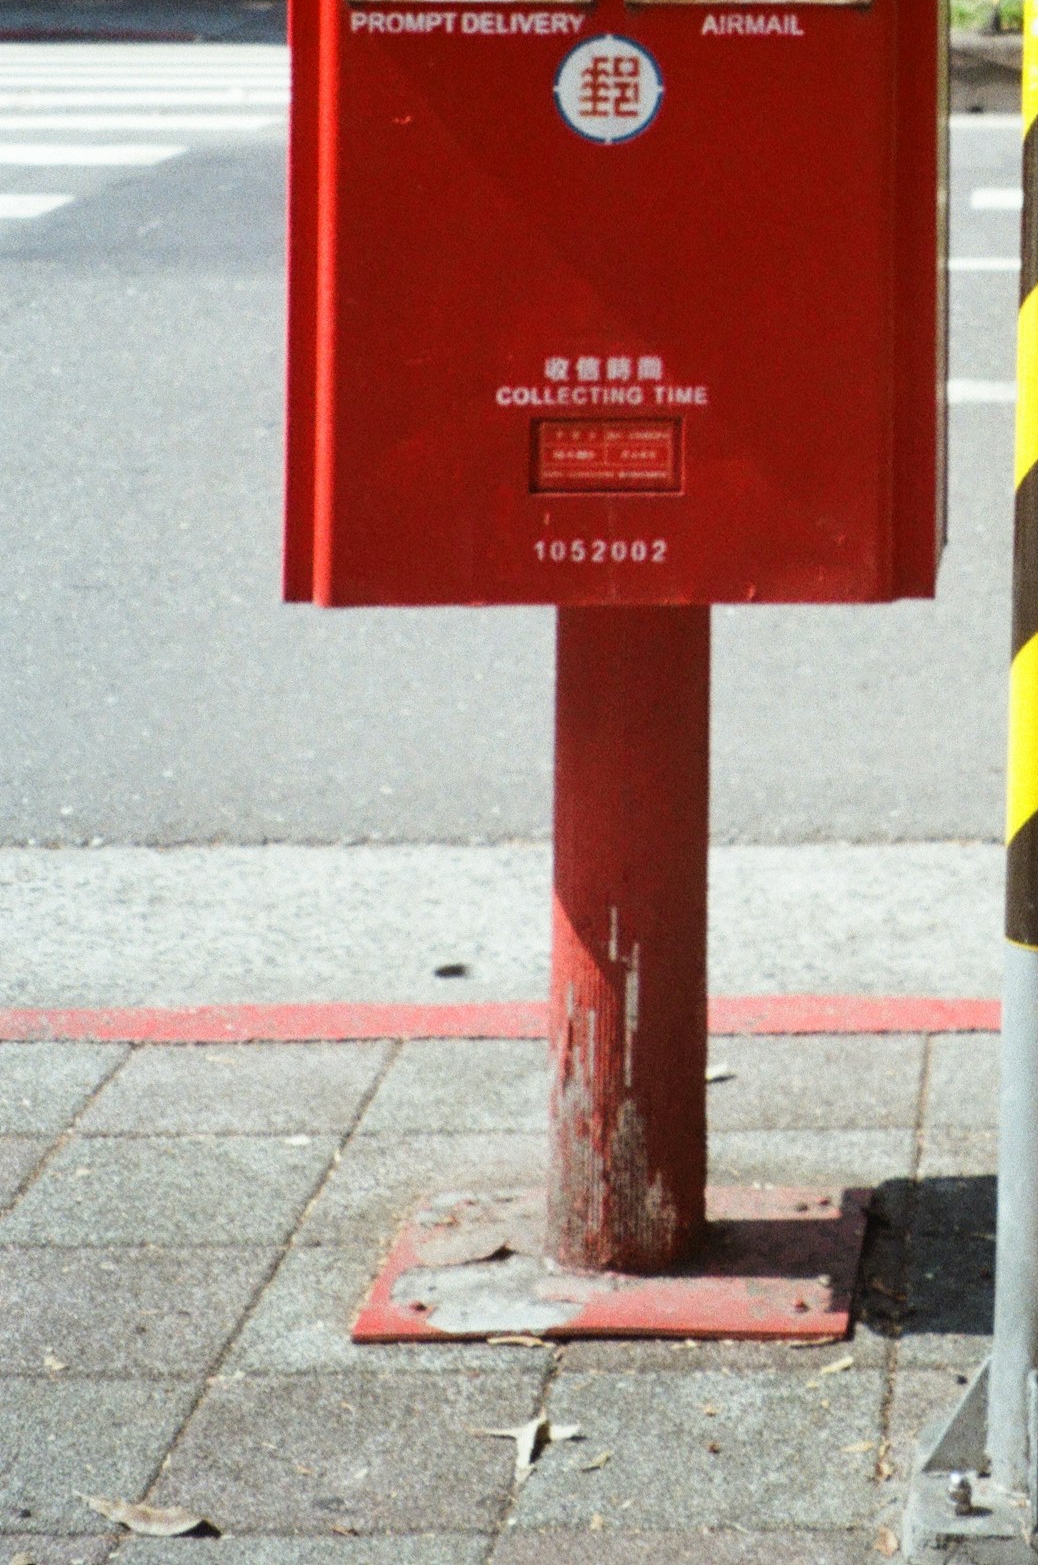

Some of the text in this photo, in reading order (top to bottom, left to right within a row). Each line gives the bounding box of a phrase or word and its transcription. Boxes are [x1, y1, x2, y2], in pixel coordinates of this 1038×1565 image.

[350, 12, 584, 35] PROMPT DELIVERY
[701, 13, 805, 37] AIRMAIL
[544, 355, 664, 382] 收信時間
[495, 385, 709, 406] COLLECTING TIME
[534, 538, 668, 563] 1052002
